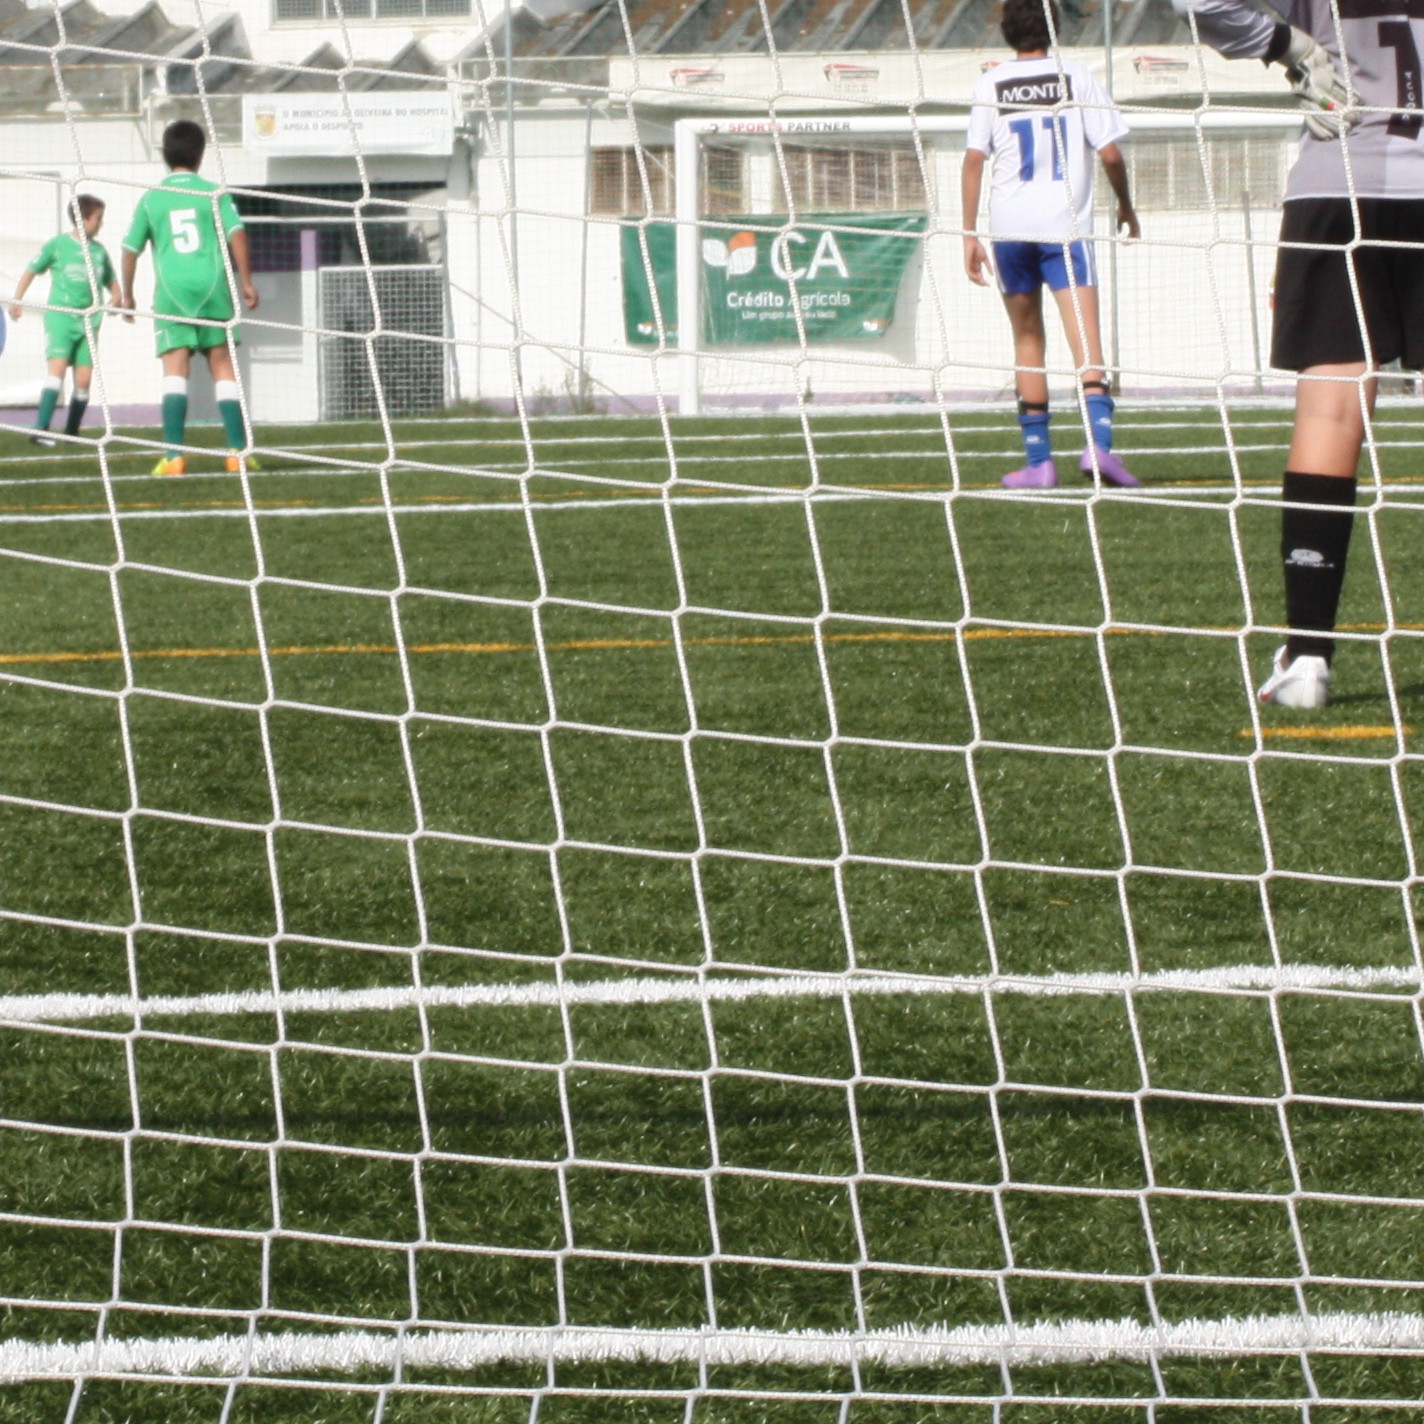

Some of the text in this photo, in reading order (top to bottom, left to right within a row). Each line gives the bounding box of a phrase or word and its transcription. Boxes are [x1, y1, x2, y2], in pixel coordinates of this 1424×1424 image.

[1377, 21, 1423, 141] 1
[284, 122, 309, 131] APOIA
[354, 108, 392, 117] OLIVEIRA
[409, 108, 449, 117] HOSPITAL
[728, 121, 851, 133] SPORTS PARTNER
[1008, 116, 1068, 181] 11
[169, 208, 200, 254] 5
[770, 230, 849, 281] CA
[727, 291, 784, 308] Crédito
